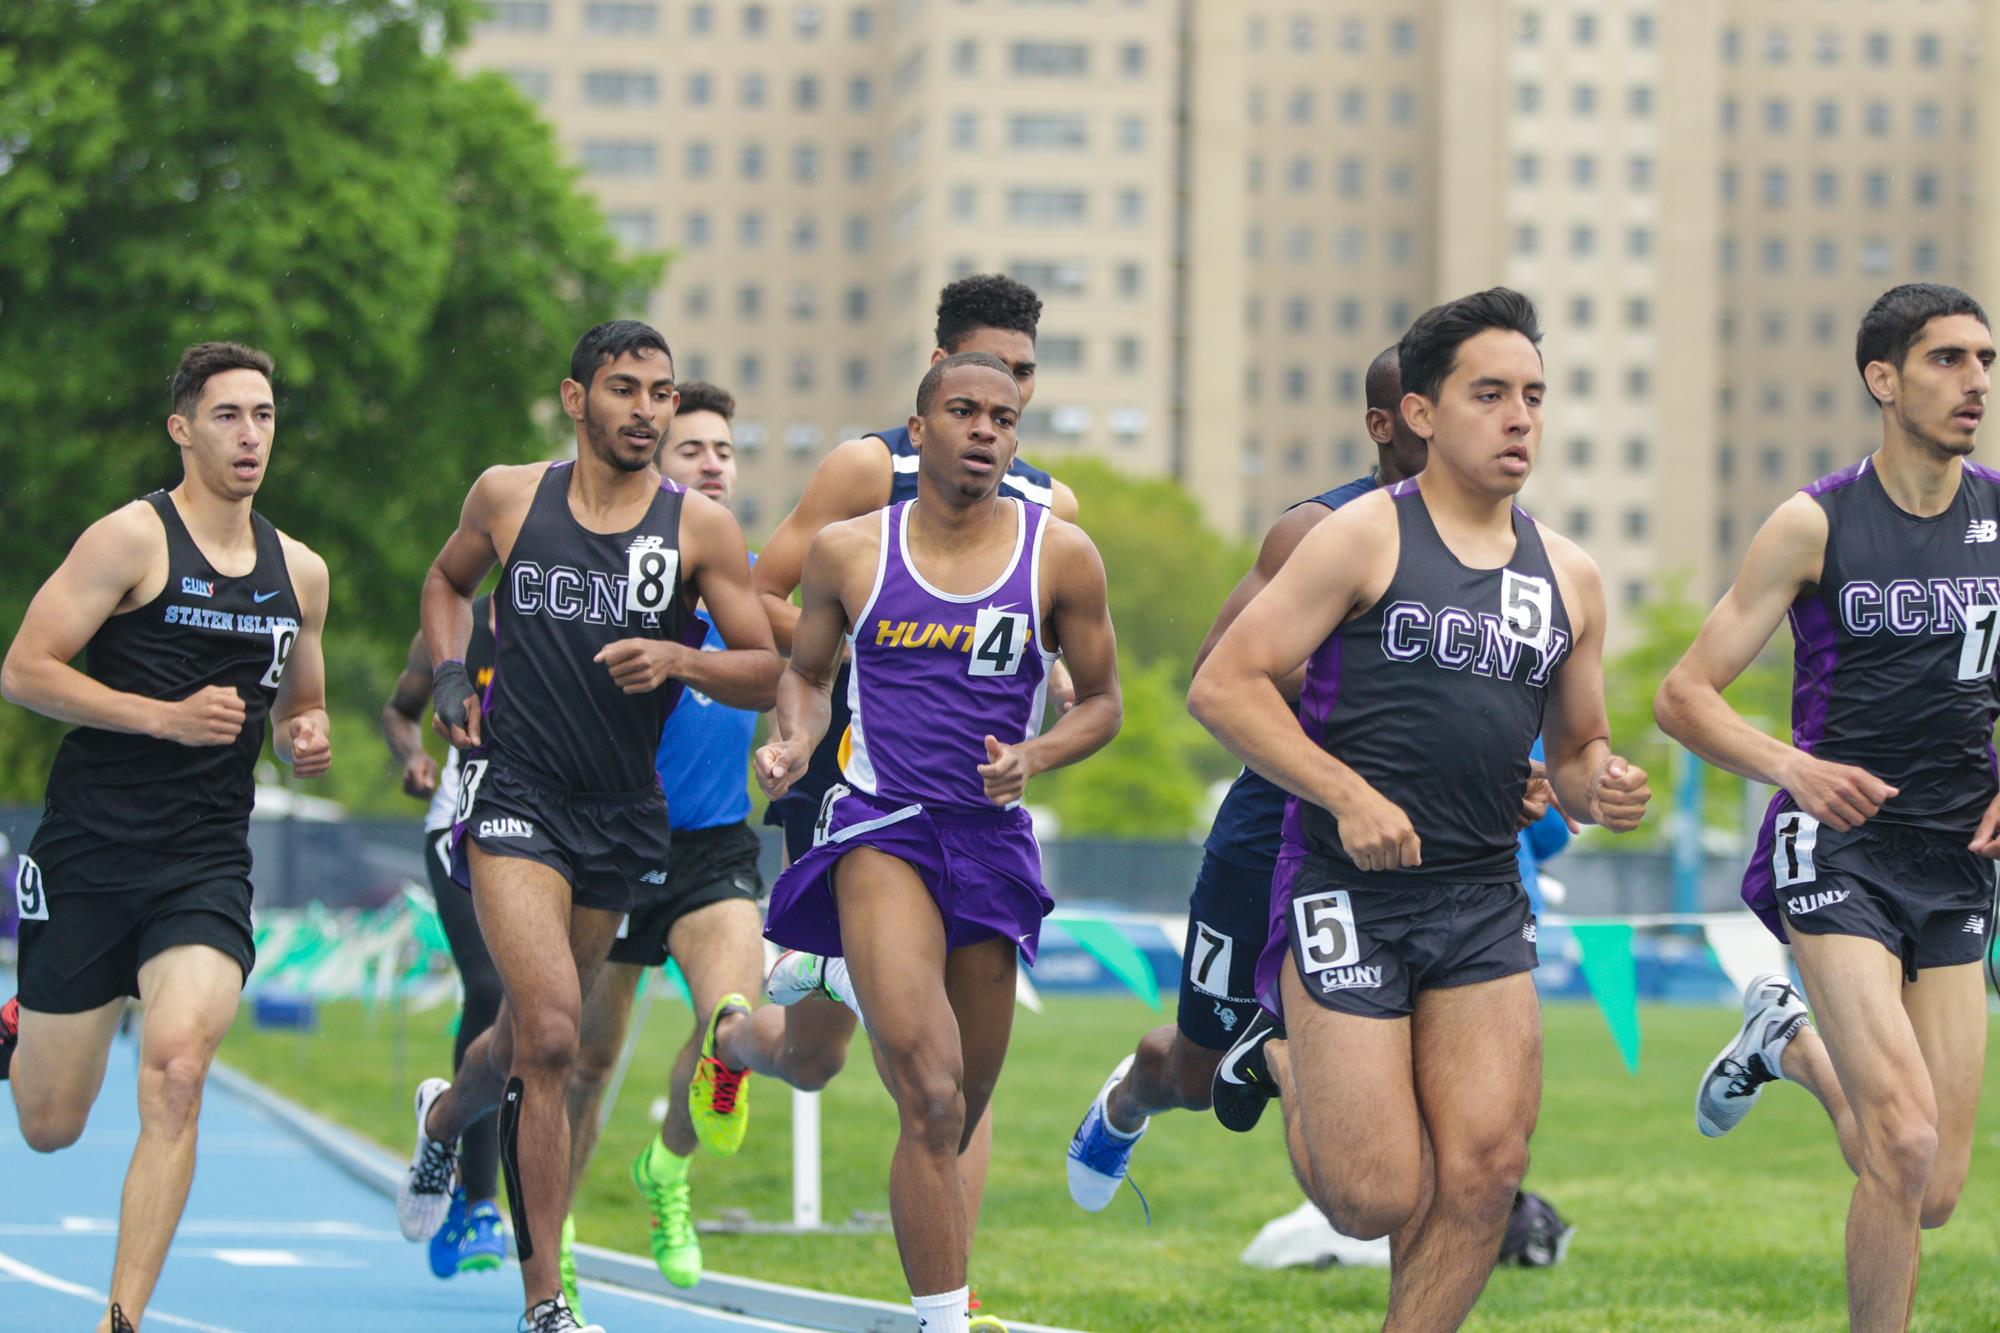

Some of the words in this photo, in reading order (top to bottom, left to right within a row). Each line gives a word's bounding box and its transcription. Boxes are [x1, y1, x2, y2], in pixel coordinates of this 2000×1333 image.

[181, 576, 215, 598] CUNY
[511, 560, 661, 629] CCN
[636, 552, 666, 608] 8
[1839, 577, 2000, 637] CCN
[164, 605, 234, 631] STATEN
[1508, 577, 1542, 640] 5
[271, 630, 295, 684] 9
[874, 619, 1034, 655] HUNT
[976, 616, 1016, 673] 4
[1380, 600, 1569, 689] CCNY
[1975, 610, 1998, 674] 1
[459, 763, 478, 819] 8
[815, 788, 842, 841] 4
[479, 817, 533, 838] CUNY
[1779, 816, 1800, 880] 1
[20, 861, 40, 915] 9
[1787, 890, 1850, 914] CUNY
[1197, 927, 1225, 985] 7
[1303, 896, 1347, 964] 5
[1320, 965, 1382, 988] CUNY
